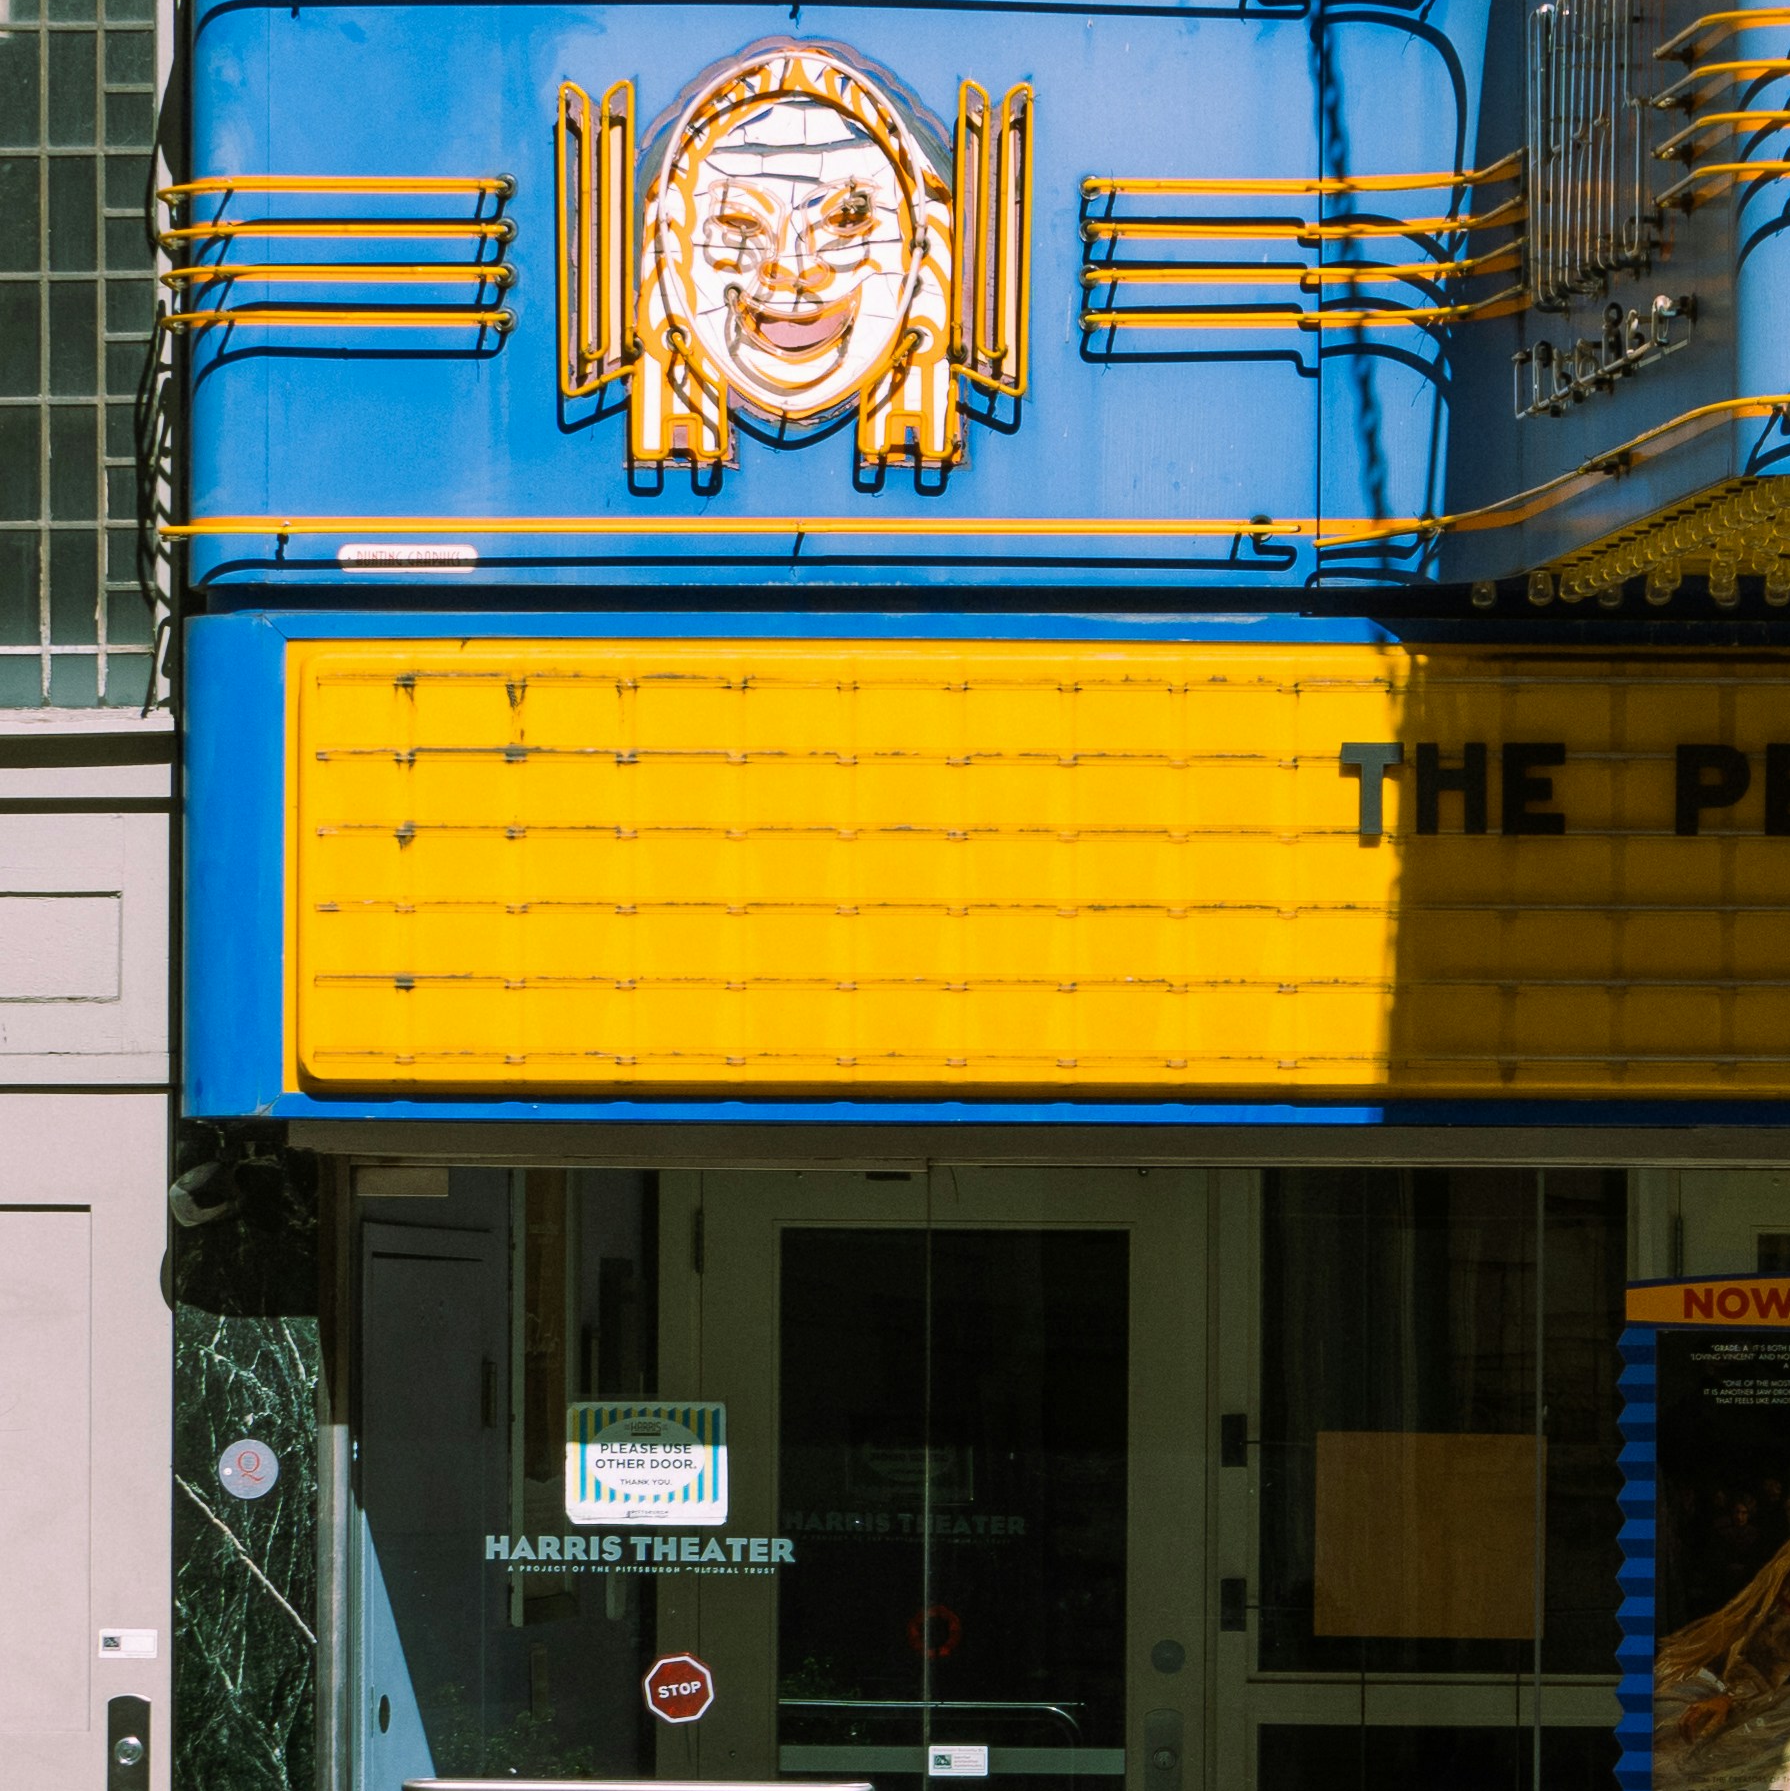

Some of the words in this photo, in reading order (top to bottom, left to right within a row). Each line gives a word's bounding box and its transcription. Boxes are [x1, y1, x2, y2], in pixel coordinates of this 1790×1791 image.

[1341, 742, 1566, 835] THE
[1758, 1353, 1776, 1361] AND
[600, 1443, 658, 1454] PLEASE
[663, 1443, 692, 1454] USE
[236, 1450, 266, 1482] Q
[595, 1459, 645, 1470] OTHER
[485, 1535, 622, 1561] HARRIS
[630, 1537, 796, 1563] THEATER
[507, 1565, 514, 1573] A
[520, 1565, 567, 1573] PROJECT
[572, 1565, 585, 1573] OF
[591, 1565, 610, 1573] THE
[615, 1565, 681, 1573] PITTSBURGH
[744, 1565, 776, 1573] TRUST
[657, 1680, 702, 1699] STOP
